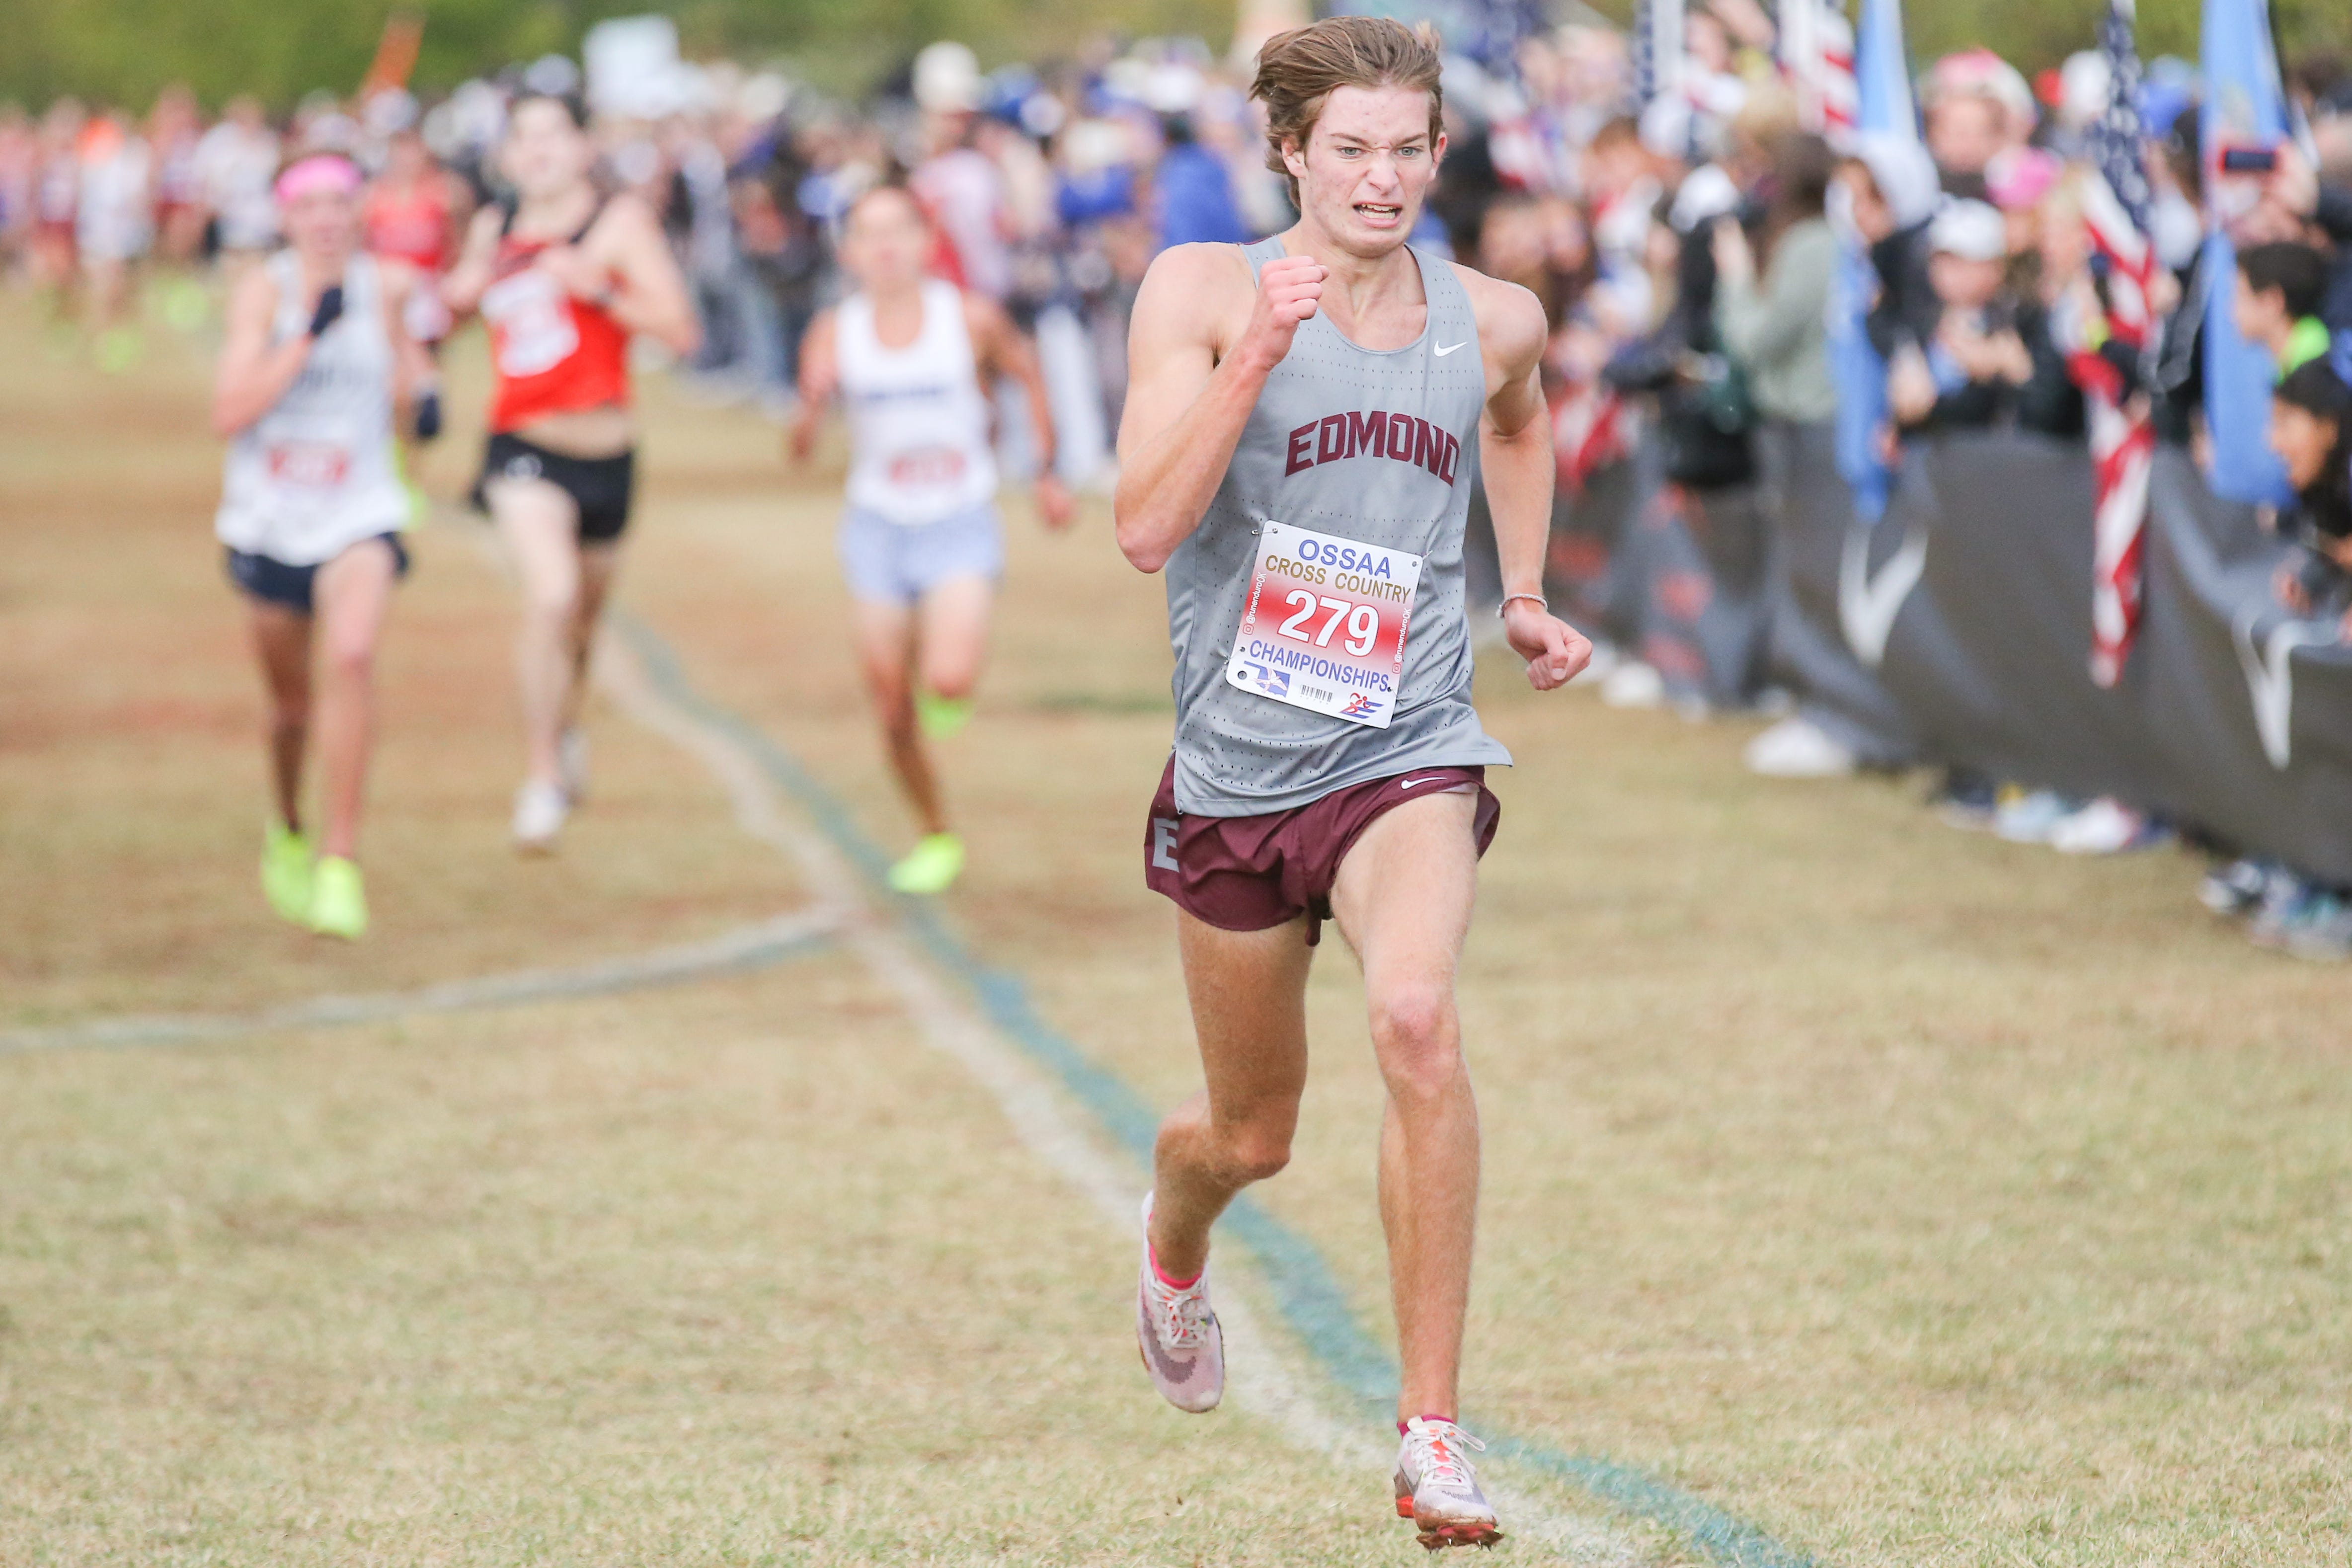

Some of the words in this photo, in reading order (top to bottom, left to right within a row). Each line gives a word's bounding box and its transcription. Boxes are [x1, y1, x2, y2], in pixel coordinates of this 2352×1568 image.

[1285, 411, 1460, 488] EDMOND
[1265, 555, 1327, 585] CROSS
[1335, 573, 1411, 604] COUNTRY
[1299, 540, 1390, 579] OSSAA
[1246, 572, 1266, 624] @runenduroOK
[1277, 589, 1379, 657] 279
[1250, 640, 1389, 692] CHAMPIONSHIPS
[1152, 818, 1179, 872] E
